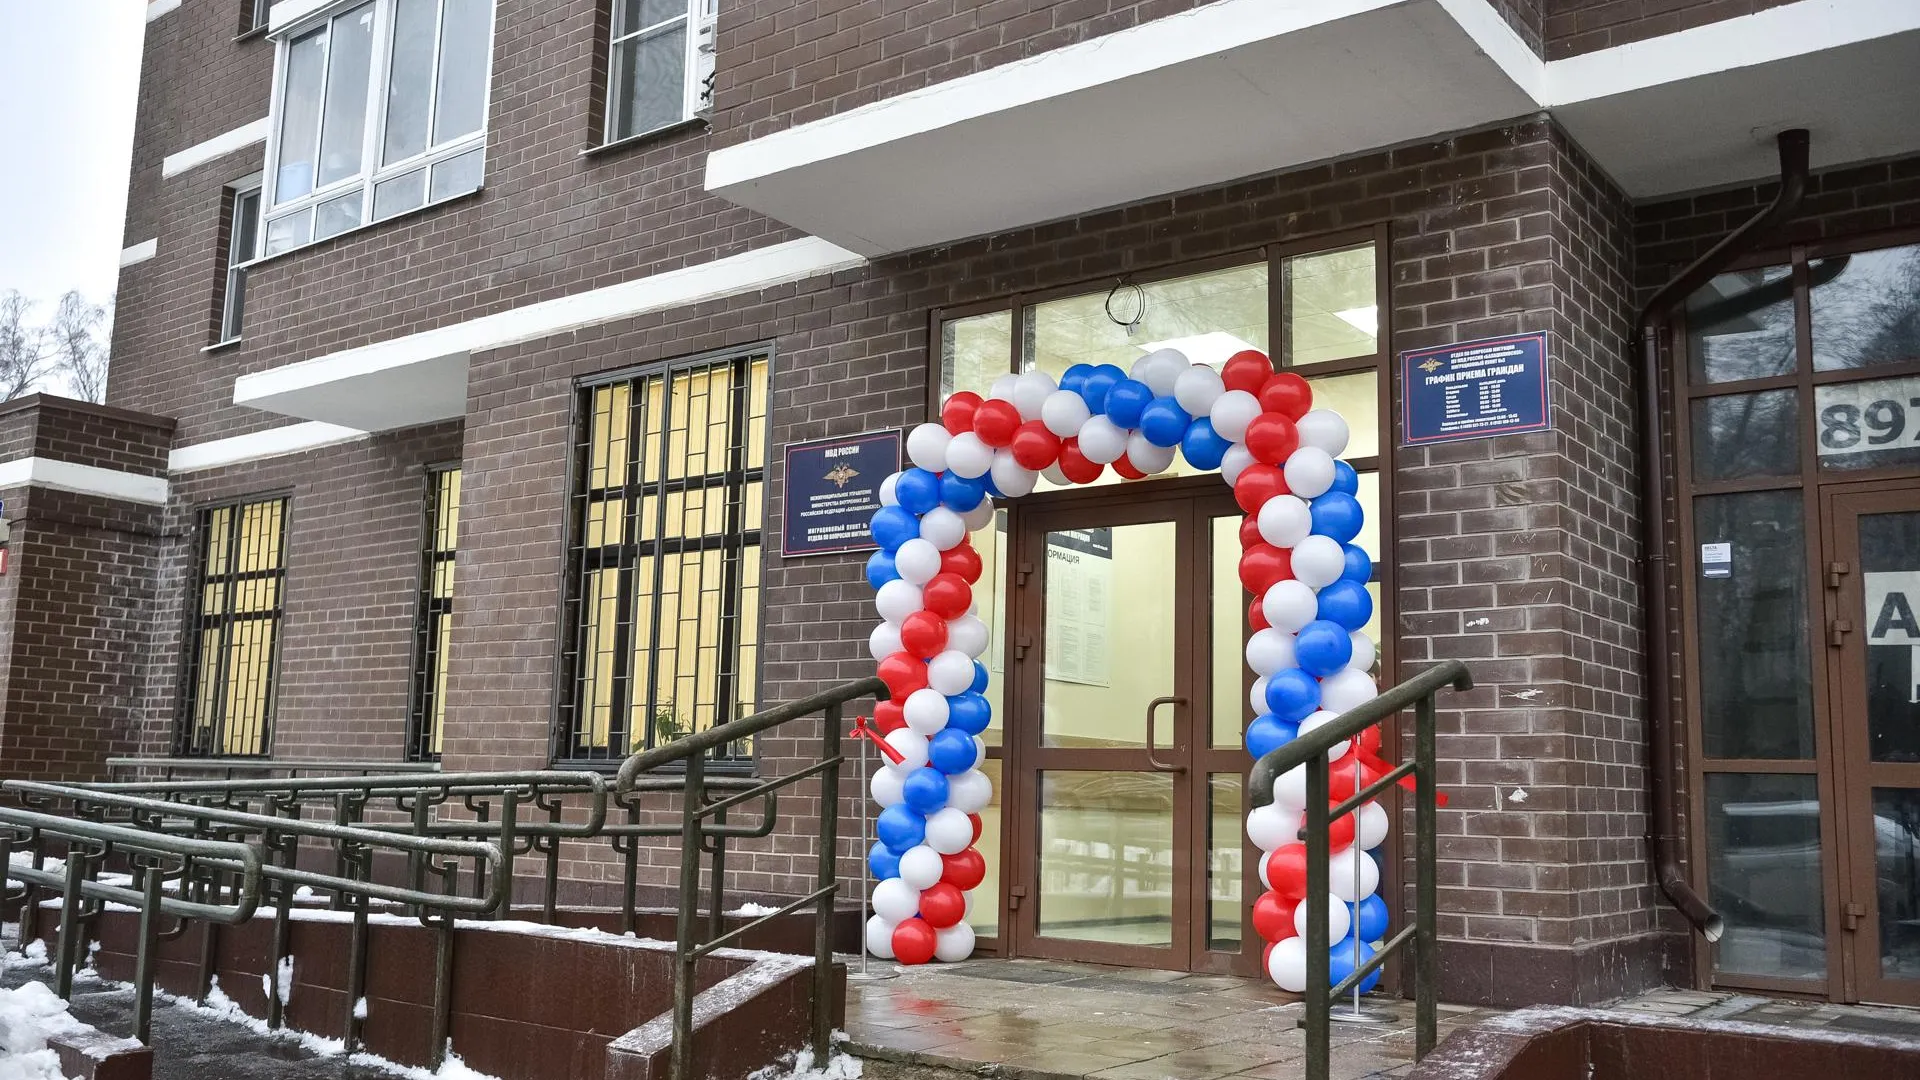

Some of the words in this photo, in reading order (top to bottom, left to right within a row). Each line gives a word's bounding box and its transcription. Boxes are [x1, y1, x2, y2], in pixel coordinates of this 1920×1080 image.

[1425, 374, 1455, 385] ГРАФИК
[1456, 368, 1486, 380] ПРИЕМА
[1487, 364, 1524, 376] ГРАЖДАН
[825, 449, 838, 458] МВД
[838, 446, 860, 456] РОССИИ
[800, 509, 824, 517] РОССИЙСКОЙ
[824, 506, 845, 514] ФЕДЕРАЦИИ
[808, 524, 845, 534] МИГРАЦИОННЫЙ
